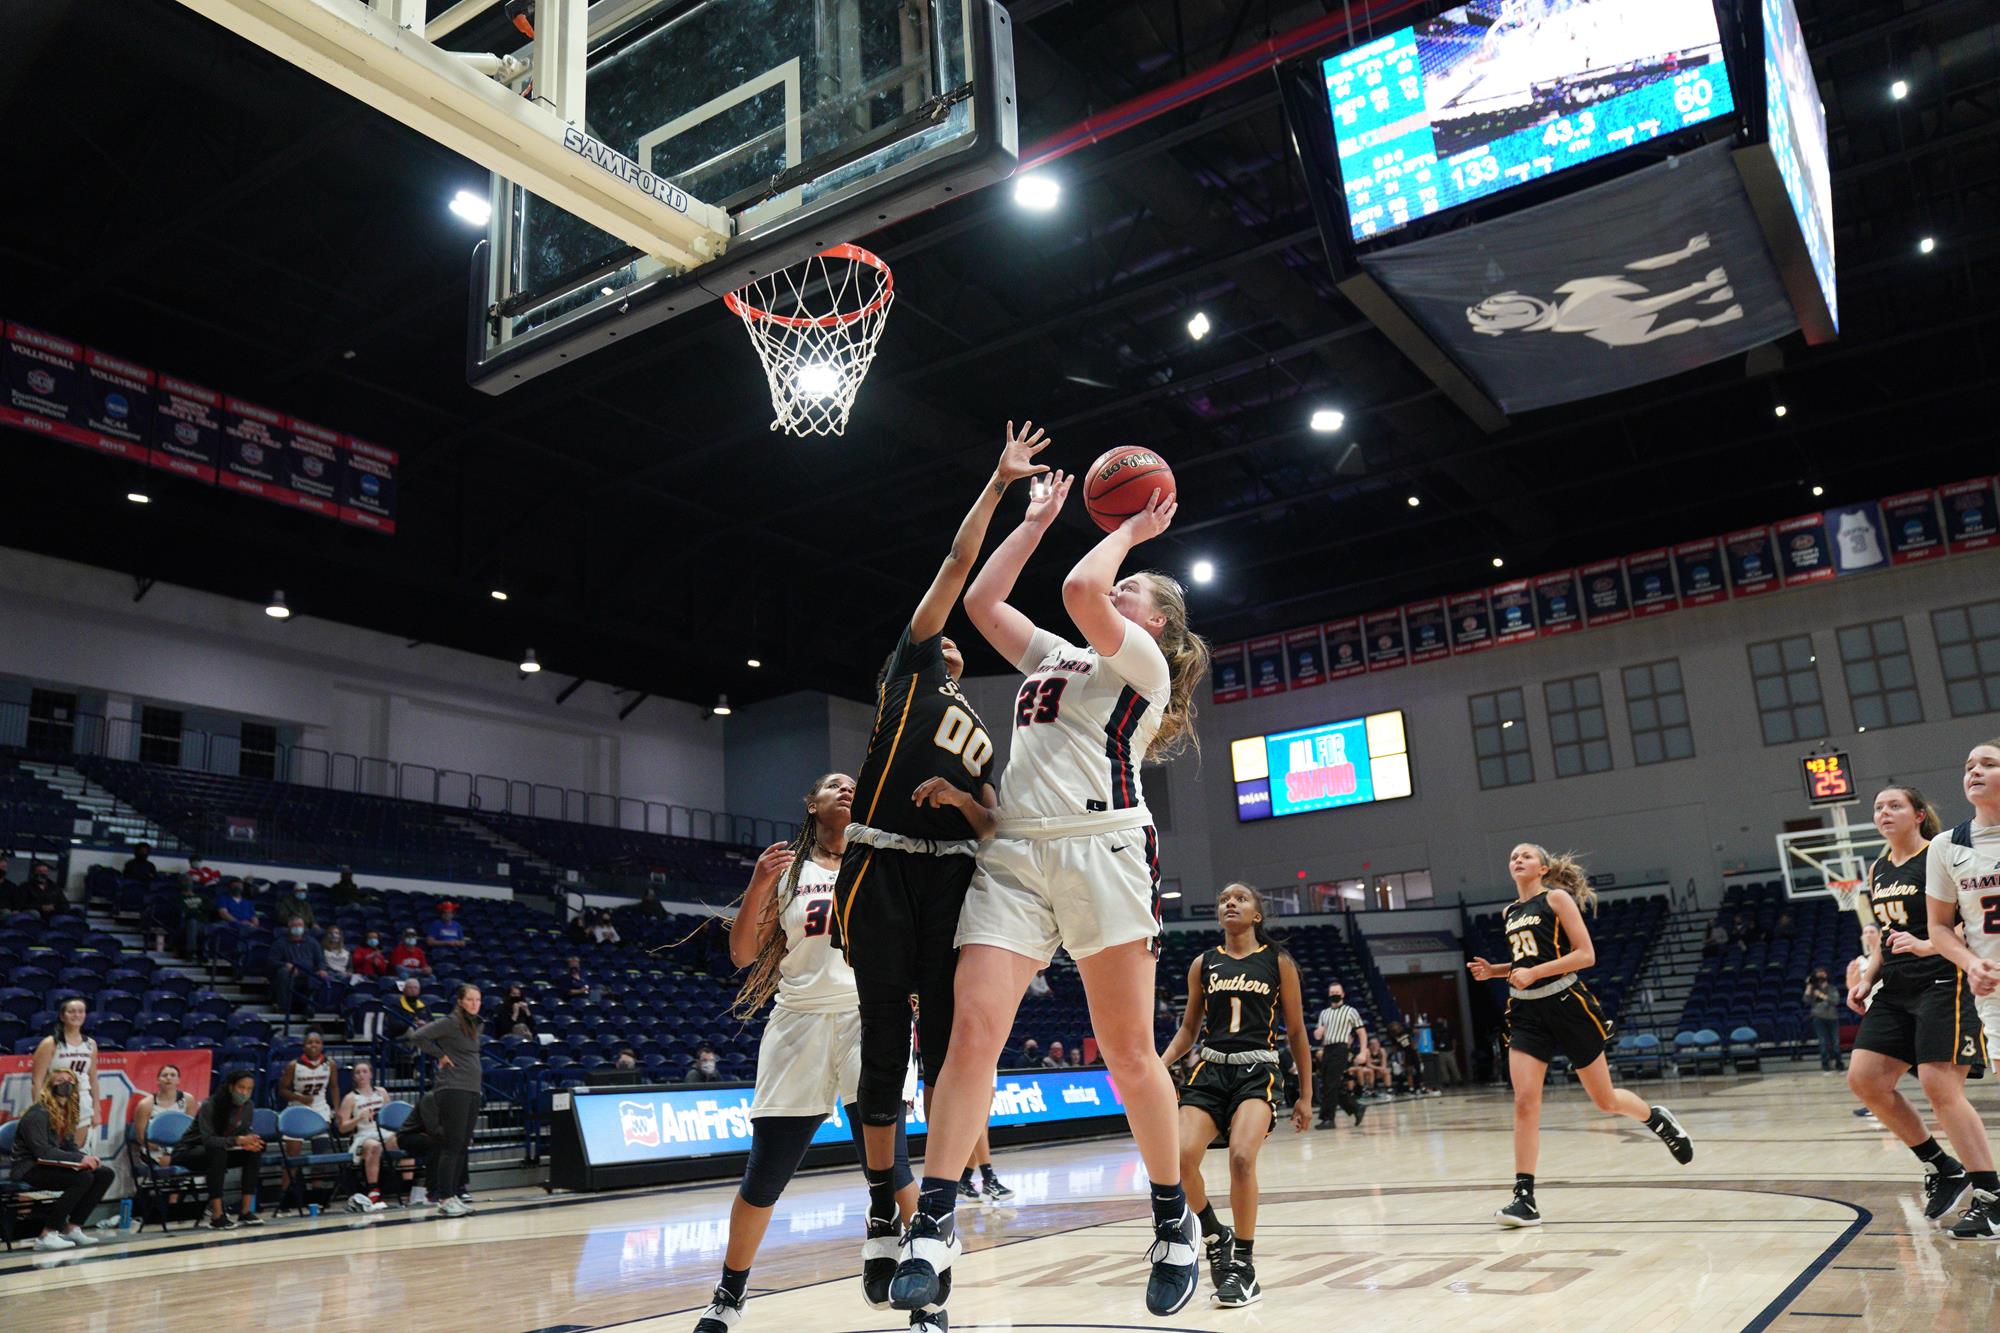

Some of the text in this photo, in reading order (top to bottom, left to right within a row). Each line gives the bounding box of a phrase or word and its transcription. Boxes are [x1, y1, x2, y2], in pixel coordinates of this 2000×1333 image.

[1543, 112, 1596, 147] 43.3
[564, 127, 688, 214] SAMFORD
[1450, 156, 1499, 191] 133
[11, 343, 75, 370] VOLLEYBALL
[90, 368, 148, 394] VOLLEYBALL
[1016, 677, 1068, 729] 23
[934, 705, 993, 777] 00
[1316, 733, 1348, 768] FOR
[1285, 762, 1357, 803] SAMFORD
[1815, 770, 1847, 796] 25
[794, 883, 836, 896] SAMF
[1872, 880, 1918, 901] Southern
[804, 899, 832, 937] 3
[1505, 914, 1541, 934] Southern
[1509, 930, 1538, 961] 20
[1208, 973, 1270, 995] Southern
[1229, 996, 1242, 1033] 1
[662, 1098, 754, 1144] AmFirst
